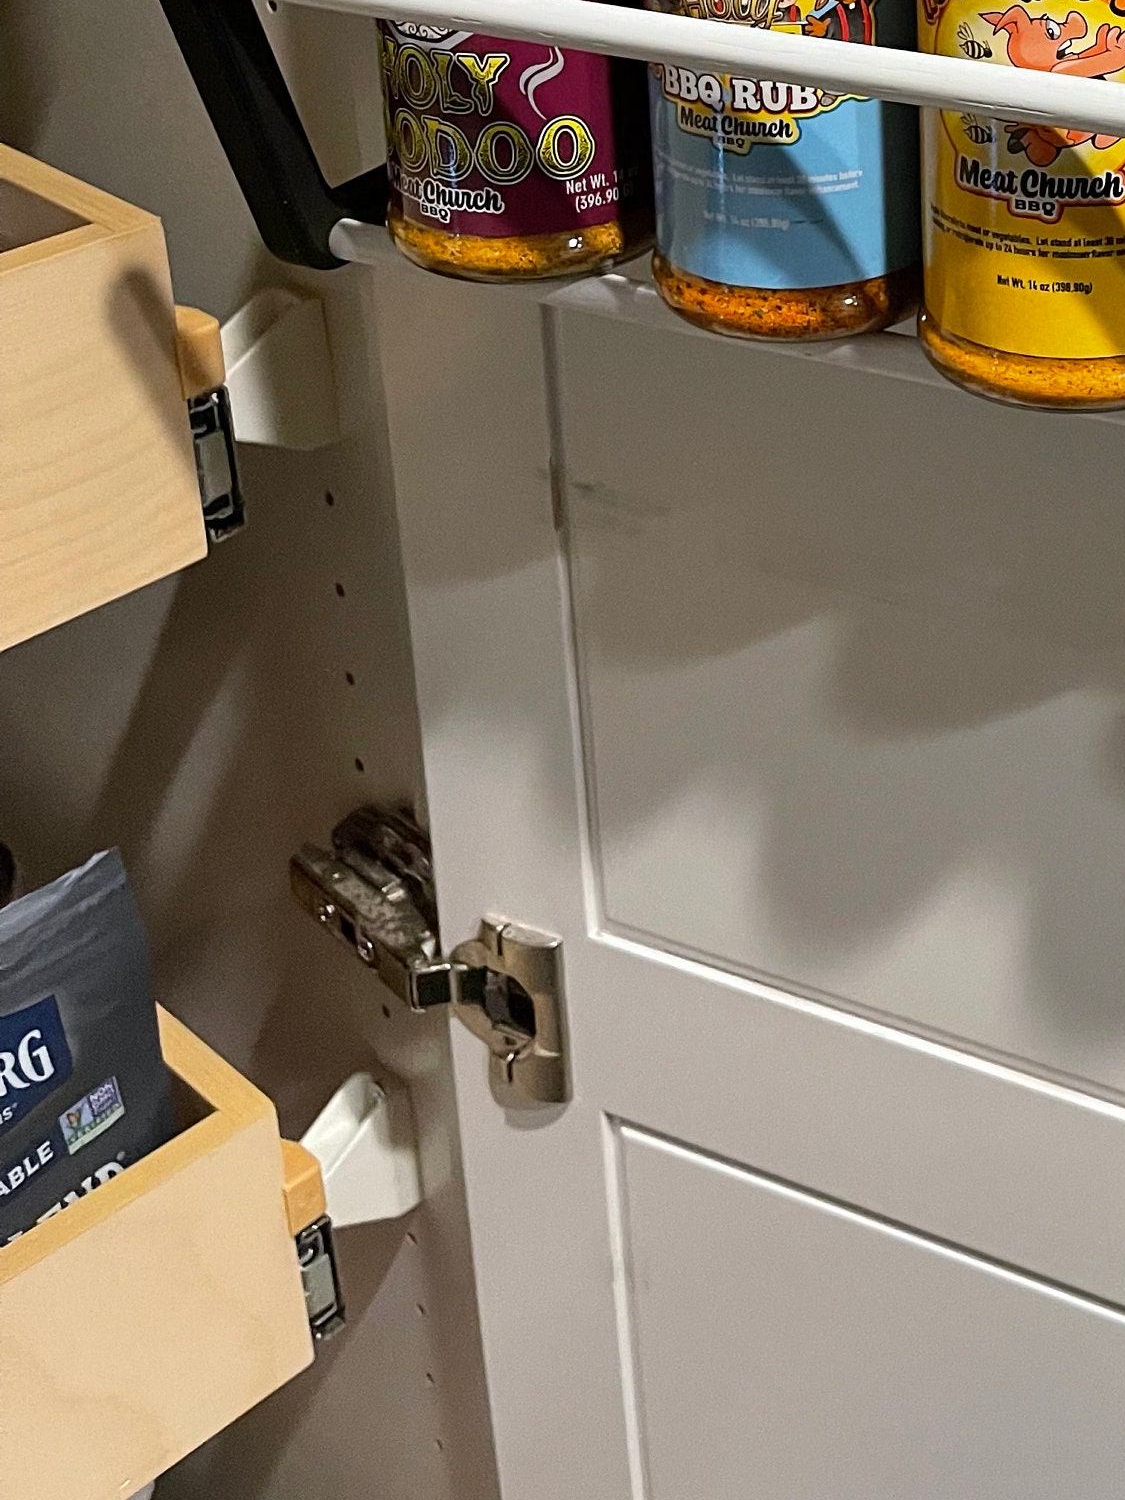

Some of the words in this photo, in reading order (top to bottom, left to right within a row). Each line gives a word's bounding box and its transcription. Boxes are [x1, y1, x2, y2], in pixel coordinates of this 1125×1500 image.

[665, 65, 723, 111] BBQ
[733, 78, 818, 112] RUB
[680, 106, 719, 132] Meat
[721, 115, 793, 138] Church
[386, 107, 596, 185] ODOO
[566, 178, 587, 195] Net
[590, 173, 610, 190] Wt.
[960, 156, 1018, 194] Meat
[1020, 170, 1124, 198] Church
[423, 180, 503, 212] Church
[575, 186, 619, 213] (396.90
[1015, 200, 1055, 216] BBQ
[421, 203, 450, 223] BBQ
[1039, 283, 1050, 292] oz
